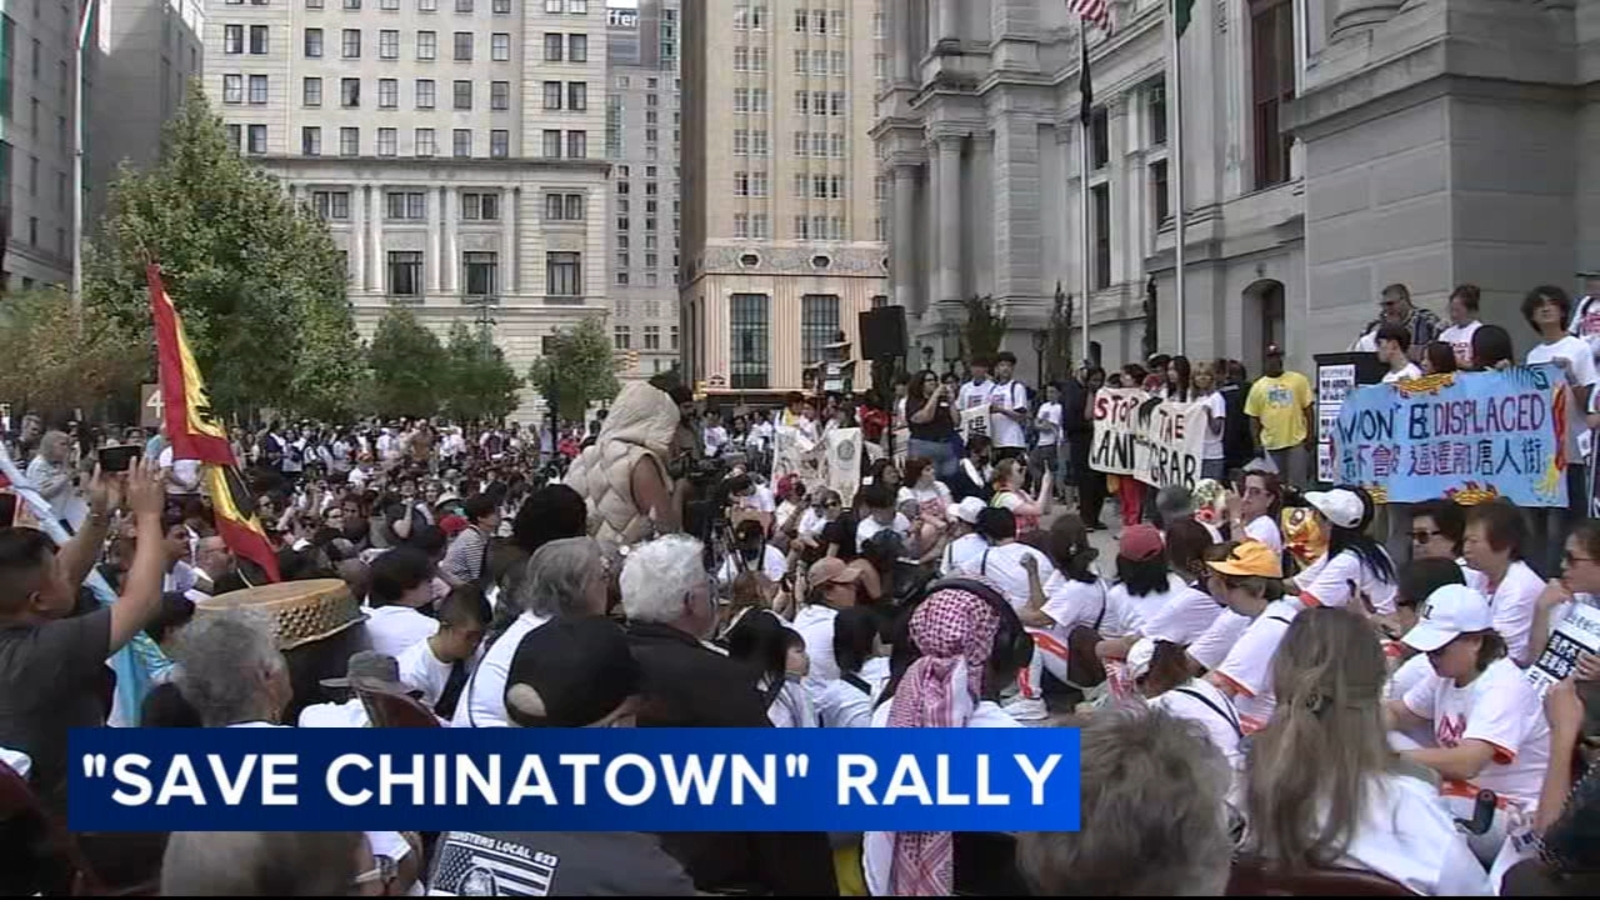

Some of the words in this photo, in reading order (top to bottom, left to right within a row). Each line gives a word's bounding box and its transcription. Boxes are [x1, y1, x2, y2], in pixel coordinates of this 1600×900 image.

[1093, 395, 1140, 430] STOP
[1433, 393, 1546, 437] DISPLACED
[1091, 429, 1136, 470] AN
[496, 838, 531, 860] LOCAL
[534, 849, 558, 867] 623
